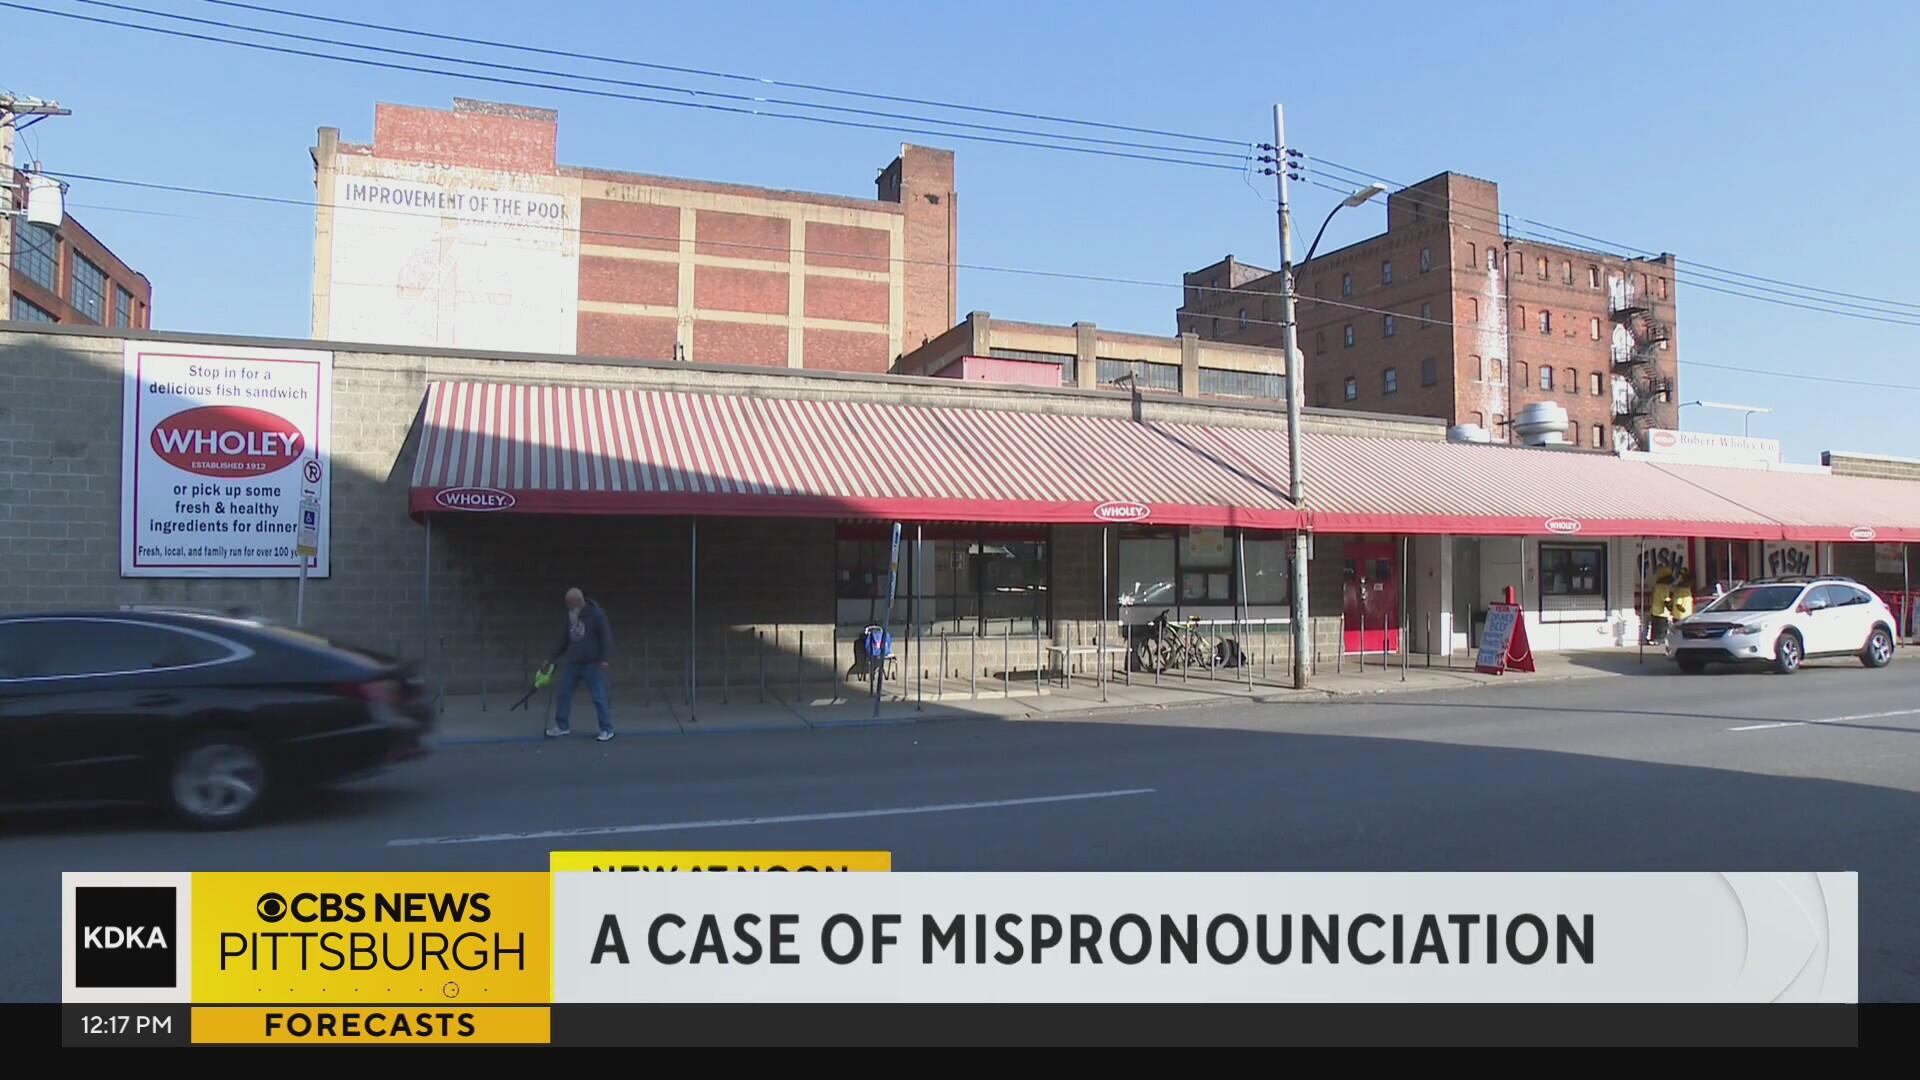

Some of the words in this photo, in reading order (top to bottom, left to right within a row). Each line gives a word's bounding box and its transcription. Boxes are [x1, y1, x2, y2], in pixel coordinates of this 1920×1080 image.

[345, 182, 464, 211] IMPROVEMENT
[469, 195, 489, 214] OF
[494, 197, 521, 217] THE
[189, 364, 220, 380] Stop
[224, 366, 237, 379] in
[241, 366, 259, 380] for
[263, 371, 271, 381] a
[149, 381, 212, 396] delicious
[216, 383, 241, 397] fish
[245, 386, 308, 400] sandwich
[156, 427, 300, 457] WHOLEY
[191, 461, 244, 471] ESTABLISHED
[245, 462, 266, 471] 1912
[173, 484, 187, 496] or
[191, 483, 221, 499] pick
[225, 486, 242, 499] up
[245, 486, 281, 497] some
[446, 494, 507, 506] WHOLEY
[175, 501, 210, 514] fresh
[214, 501, 226, 514] &
[230, 502, 279, 518] healthy
[1101, 507, 1144, 517] WHOLEY
[149, 519, 229, 534] ingredients
[232, 520, 252, 533] for
[255, 521, 298, 534] dinner
[138, 545, 163, 558] Fresh,
[164, 547, 186, 558] local,
[187, 547, 203, 557] and
[204, 547, 228, 560] family
[229, 548, 242, 557] run
[243, 548, 255, 557] for
[256, 550, 273, 558] over
[274, 547, 289, 558] 100
[1637, 546, 1684, 580] FISH
[1768, 547, 1810, 577] FISH
